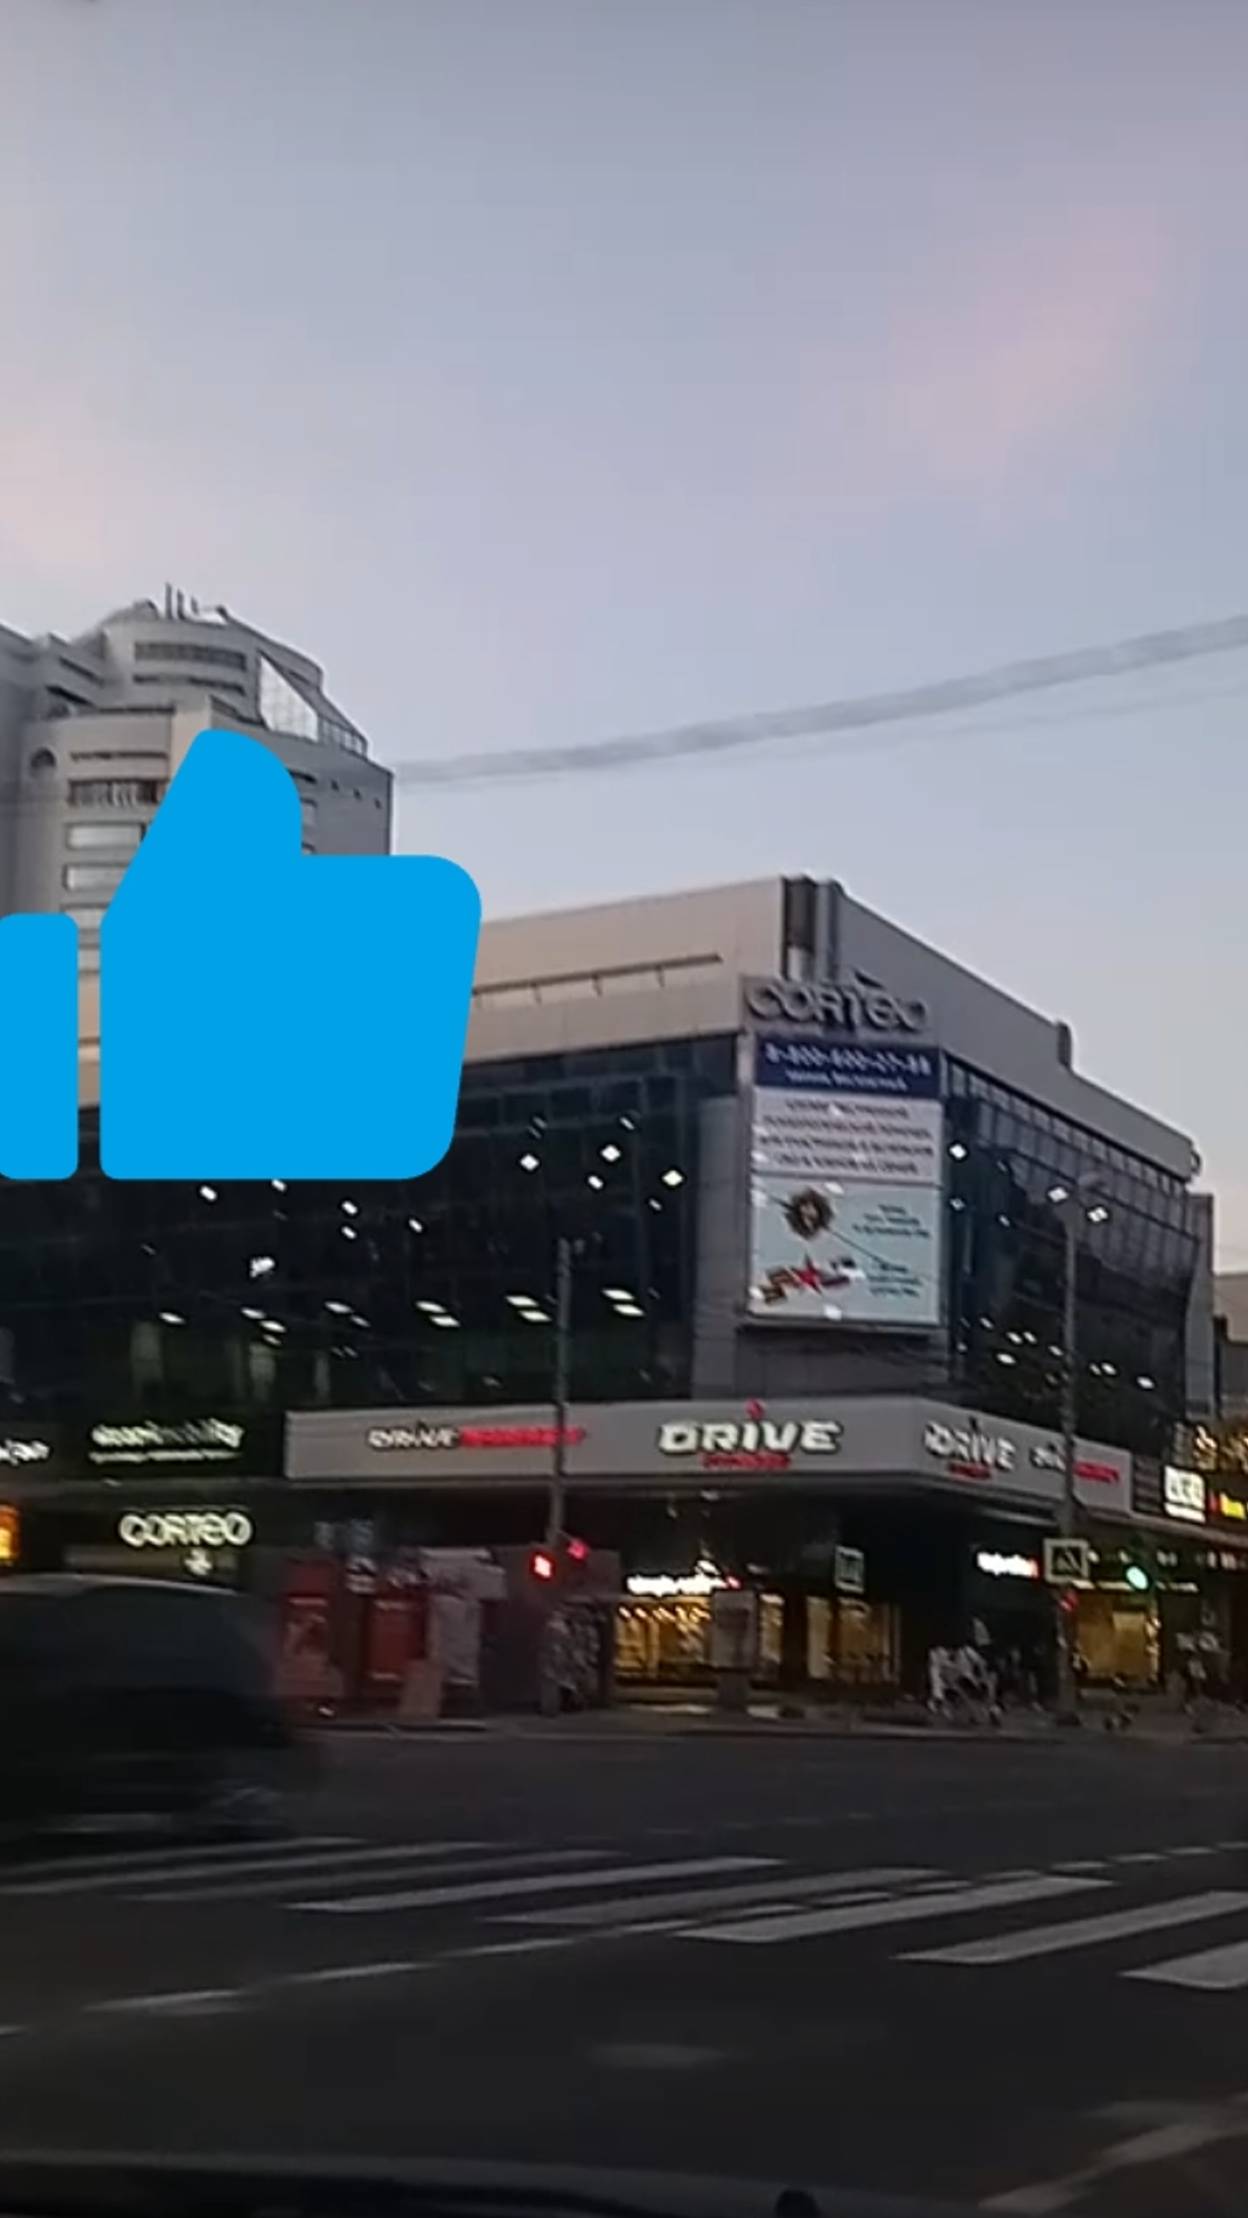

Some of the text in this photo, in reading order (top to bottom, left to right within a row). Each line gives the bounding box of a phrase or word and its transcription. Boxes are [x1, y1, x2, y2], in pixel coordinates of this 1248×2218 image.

[747, 975, 930, 1033] CORTEO
[658, 1400, 842, 1454] DRIVE
[118, 1510, 254, 1548] CORTEO
